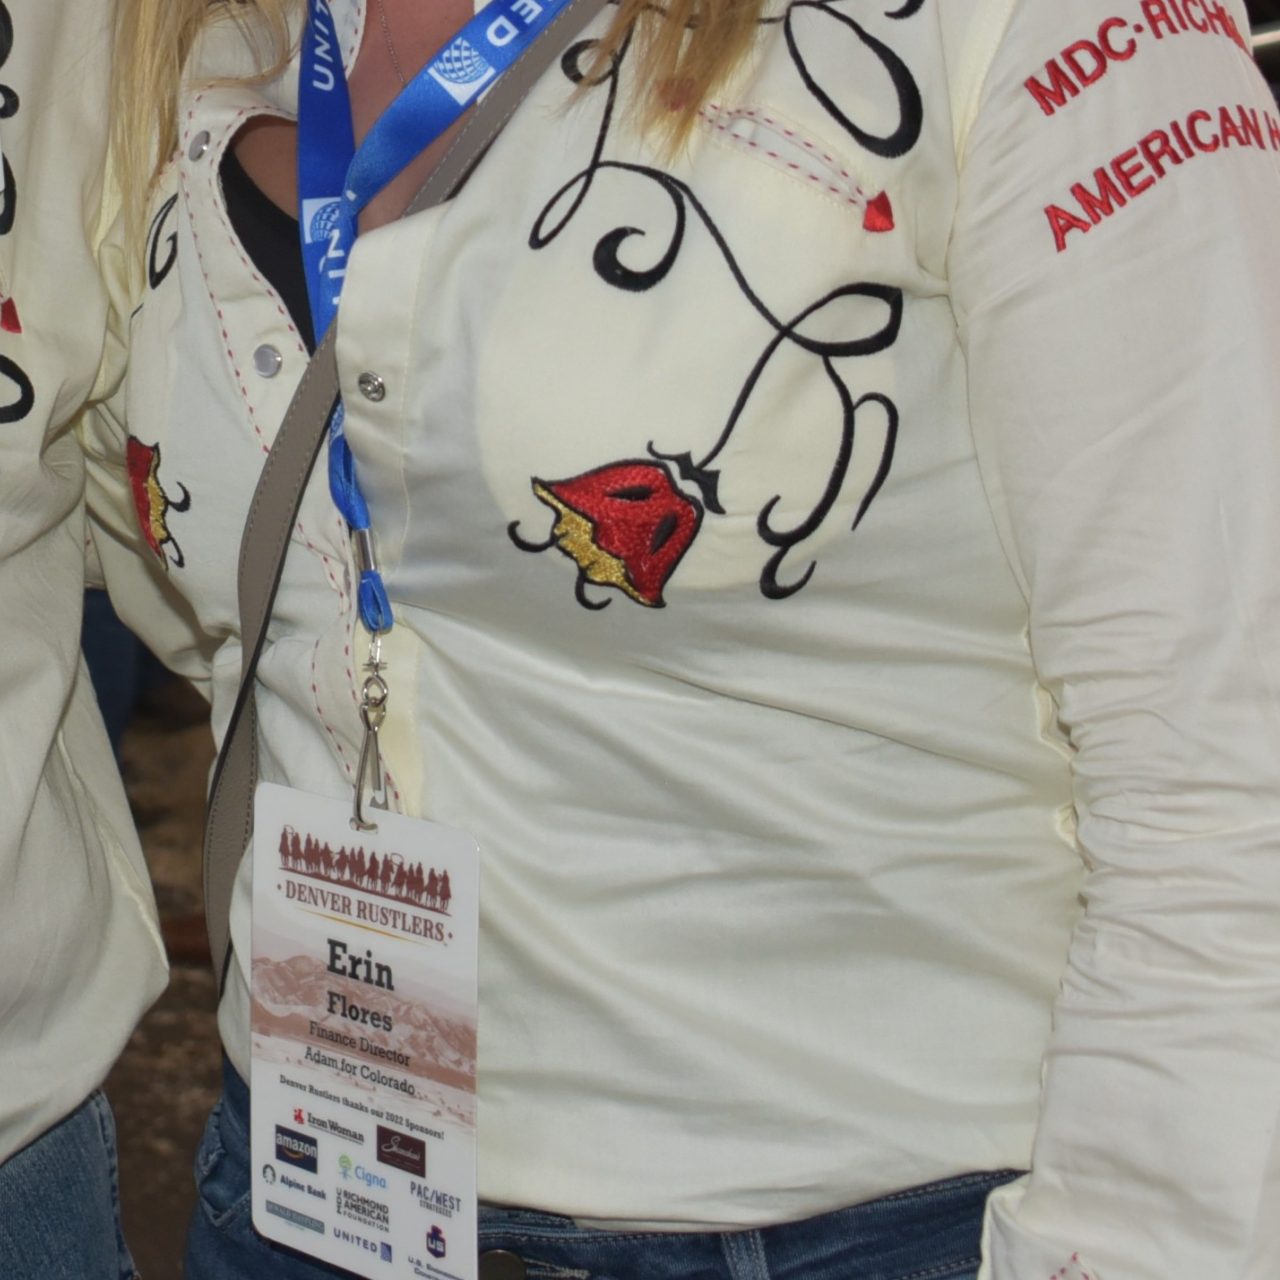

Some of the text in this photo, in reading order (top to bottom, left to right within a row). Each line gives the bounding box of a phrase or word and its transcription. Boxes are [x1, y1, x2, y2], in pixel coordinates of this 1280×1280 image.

[1044, 105, 1266, 253] AMERICAN
[286, 880, 445, 942] DENVER RUSTLERS
[326, 938, 395, 991] Erin
[326, 991, 393, 1032] Flores
[309, 1021, 411, 1067] Finance Director
[304, 1047, 415, 1095] Adam for Colorado
[280, 1074, 444, 1140] Denver Rustlers thanks our 2022 Sponsors!
[276, 1132, 317, 1156] amazon
[307, 1184, 326, 1200] Bank
[355, 1166, 387, 1189] Cigna
[343, 1190, 389, 1214] RICHMOND
[344, 1200, 389, 1225] AMERICAN
[410, 1181, 461, 1212] PAC/WEST
[333, 1227, 377, 1253] UNITED
